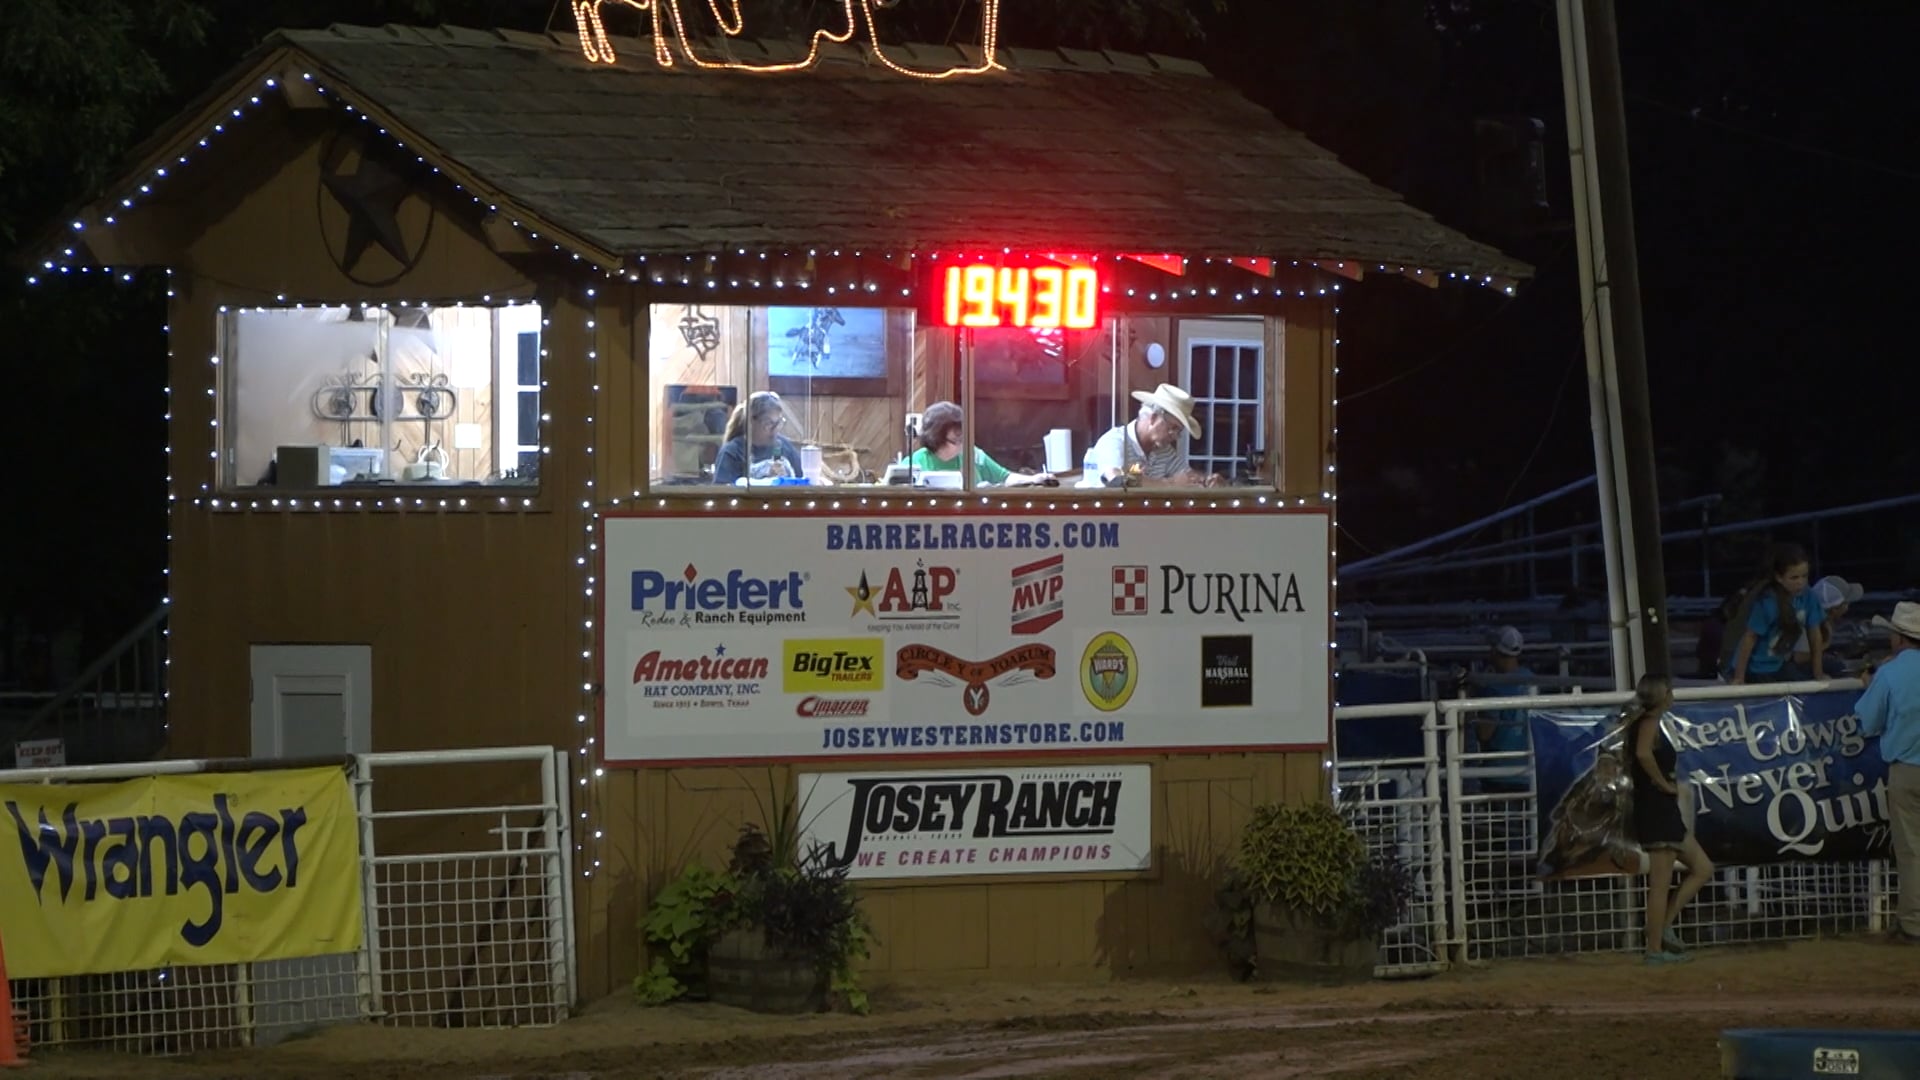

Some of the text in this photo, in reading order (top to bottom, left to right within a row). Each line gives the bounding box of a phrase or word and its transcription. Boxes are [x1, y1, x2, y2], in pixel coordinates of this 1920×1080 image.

[827, 523, 1120, 550] BARRELRACERS.COM
[631, 563, 804, 611] Priefert
[1012, 574, 1064, 612] MVP
[1160, 564, 1305, 622] PURINA
[695, 611, 735, 624] Ranch
[739, 611, 806, 625] Equipment
[633, 650, 768, 684] American
[831, 672, 873, 682] TRAILERS
[900, 649, 951, 667] CIRCLE
[991, 650, 1050, 672] YOAKUM
[1205, 667, 1249, 680] MARSHALL
[644, 683, 760, 697] HAT COMPANY, INC.
[823, 722, 1124, 749] JOSEYWESTERNSTORE.COM
[1664, 704, 1866, 761] Real Cowg
[1688, 755, 1834, 814] Never
[826, 775, 1121, 869] JOSEY RANCH
[1767, 772, 1890, 856] Quit
[6, 793, 307, 947] Wrangler
[858, 845, 1112, 867] WE CREATE CHAMPIONS
